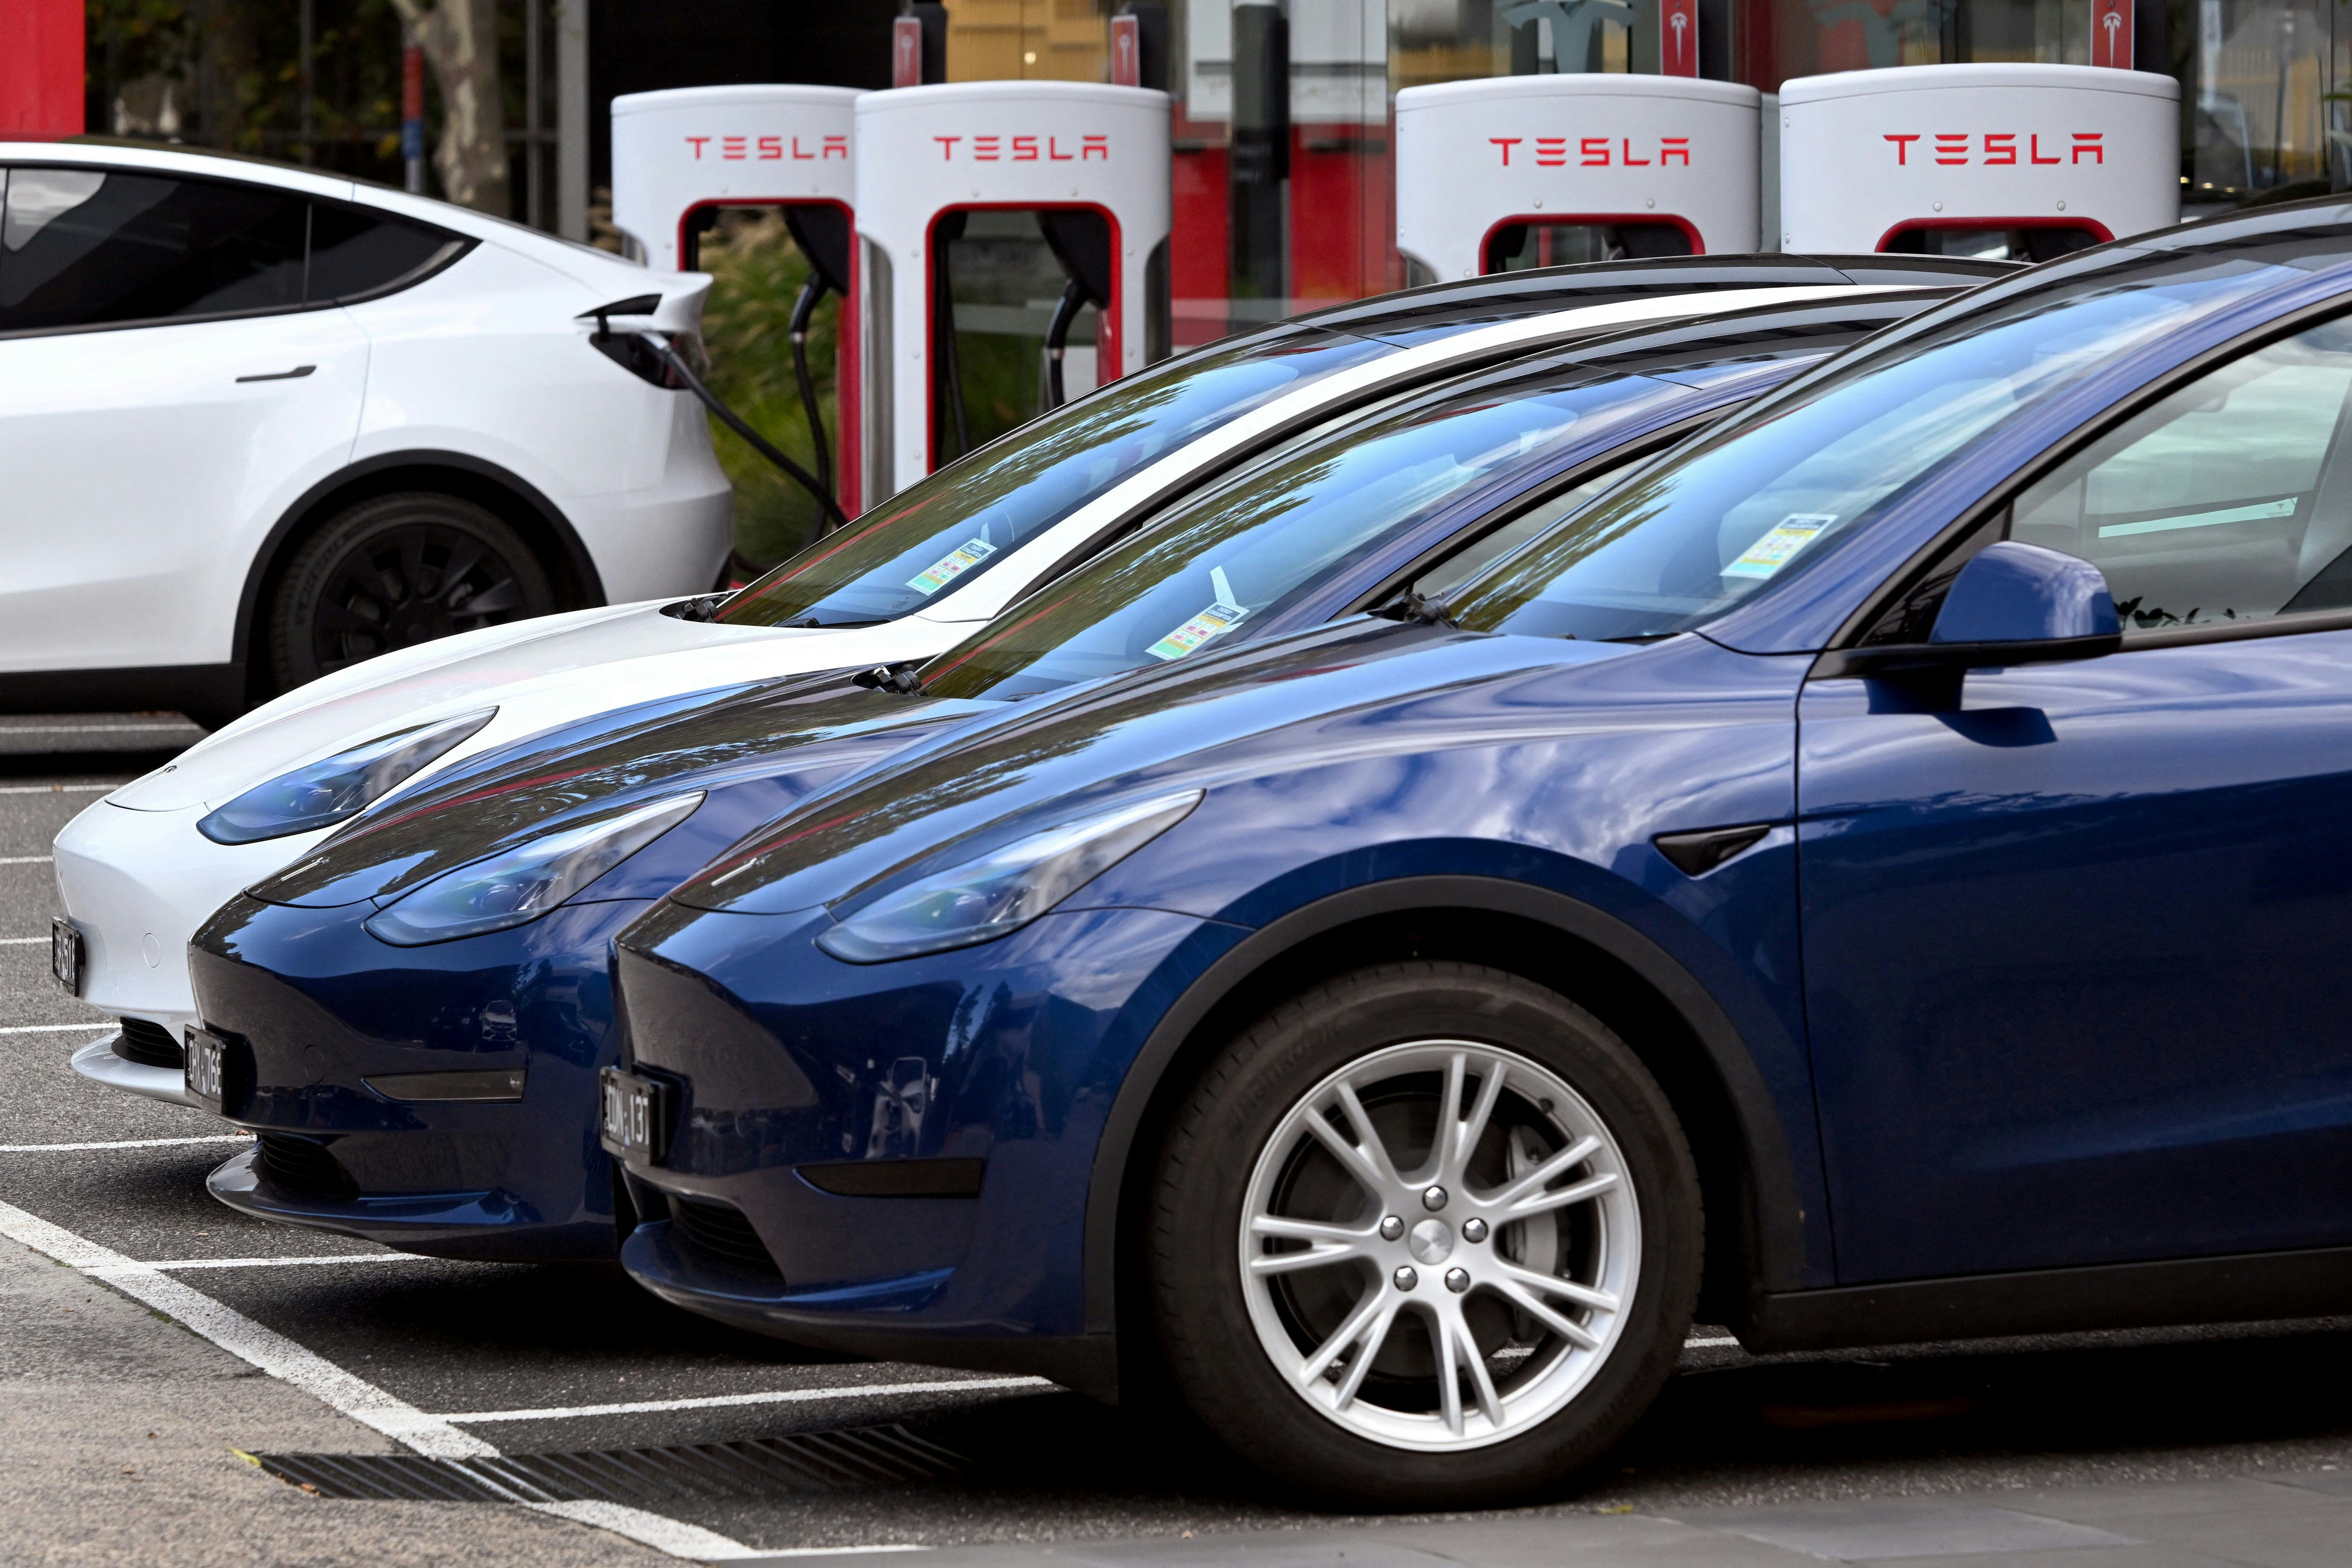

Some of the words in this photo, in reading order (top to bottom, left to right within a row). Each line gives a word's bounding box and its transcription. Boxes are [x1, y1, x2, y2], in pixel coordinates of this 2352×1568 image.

[686, 136, 848, 160] TESLA
[934, 136, 1108, 161] TESLA
[1489, 137, 1690, 167] TESLA
[1883, 133, 2104, 165] TESLA
